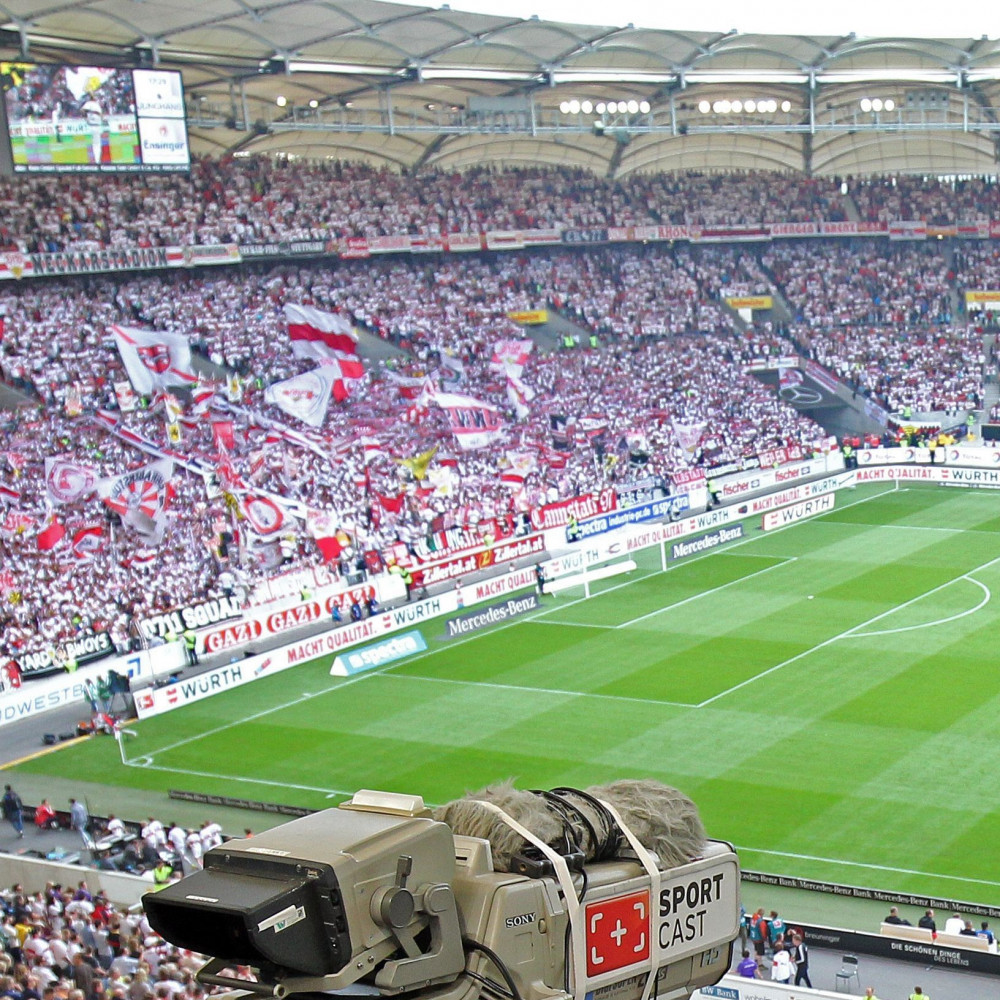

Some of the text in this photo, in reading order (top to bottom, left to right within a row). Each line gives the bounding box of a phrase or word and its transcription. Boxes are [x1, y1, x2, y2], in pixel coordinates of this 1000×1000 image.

[33, 248, 168, 274] NECKARSTADION
[723, 480, 749, 496] fischer
[775, 467, 800, 482] fischer
[856, 468, 885, 480] MACHT
[952, 469, 999, 482] WÜRTH
[753, 497, 773, 512] MACHT
[811, 477, 838, 493] WÜRTH
[782, 496, 830, 523] WÜRTH
[627, 534, 651, 550] MACHT
[697, 511, 729, 528] WÜRTH
[673, 525, 742, 559] Mercedes-Benz
[423, 556, 476, 584] Zillertal.at
[494, 536, 543, 563] Zillertal.at
[476, 578, 506, 599] MACHT
[270, 603, 318, 632] GAZI
[448, 595, 537, 637] Mercedes-Benz
[182, 666, 242, 699] WÜRTH
[287, 639, 324, 664] MACHT
[394, 600, 441, 625] WÜRTH
[207, 623, 259, 652] GAZI
[659, 873, 724, 917] SPORT
[741, 873, 778, 886] cedes-Benz
[779, 876, 797, 888] Bank
[800, 880, 852, 896] Mercedes-Benz
[853, 887, 872, 899] Bank
[874, 891, 929, 907] Mercedes-Benz
[930, 899, 950, 911] Bank
[506, 913, 537, 928] SONY
[659, 910, 707, 949] CAST
[891, 942, 903, 952] DIE
[904, 944, 938, 957] SCHÖNEN
[717, 987, 738, 999] Bank
